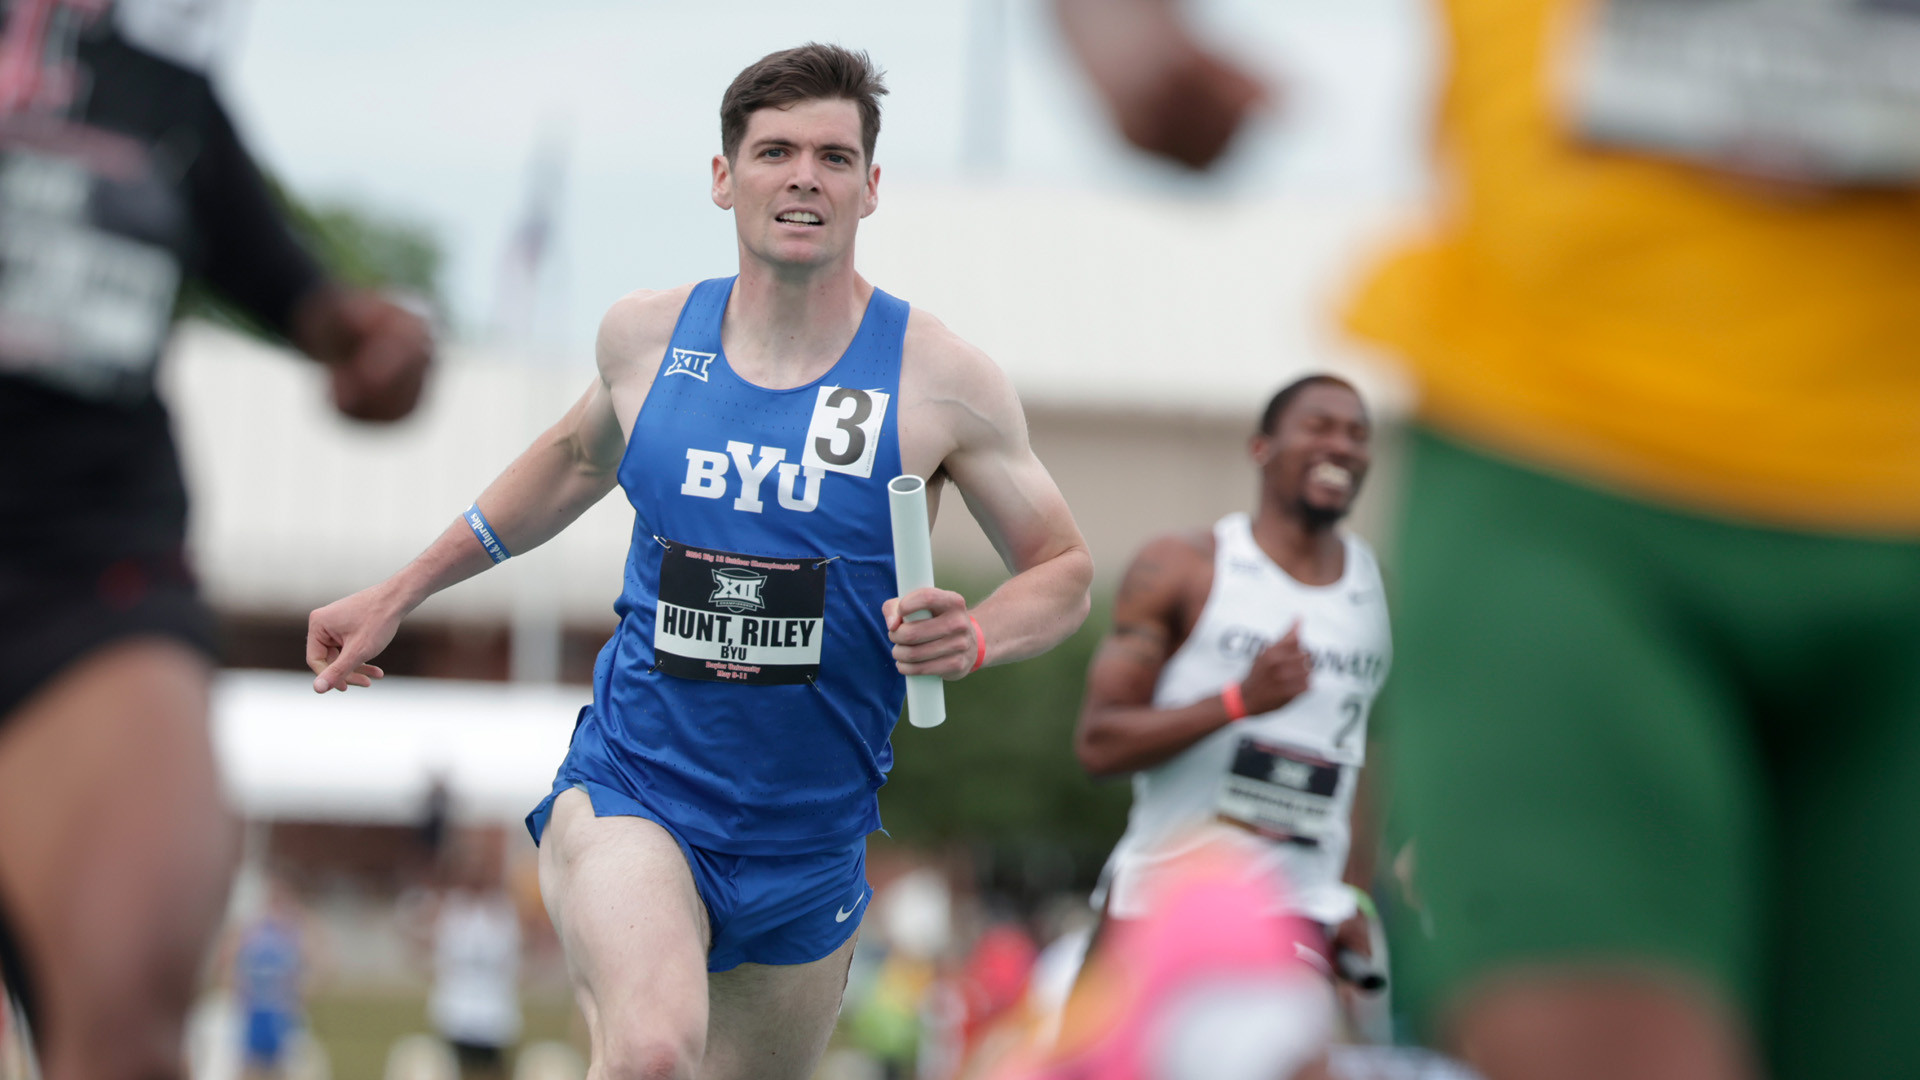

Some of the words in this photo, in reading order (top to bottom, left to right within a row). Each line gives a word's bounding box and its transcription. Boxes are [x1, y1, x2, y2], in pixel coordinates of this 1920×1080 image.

[815, 387, 873, 466] 3
[681, 440, 826, 513] BYU
[471, 512, 496, 547] Hurdles
[490, 544, 500, 553] &
[702, 552, 714, 562] Big
[716, 555, 724, 563] 12
[725, 556, 750, 566] Outdoor
[750, 560, 800, 571] Championships
[713, 574, 763, 604] XII
[663, 605, 733, 647] HUNT,
[741, 618, 816, 647] RILEY
[705, 661, 727, 670] Baylor
[728, 663, 761, 674] University
[720, 645, 747, 661] BYU
[717, 670, 731, 679] May
[1333, 700, 1362, 749] 2
